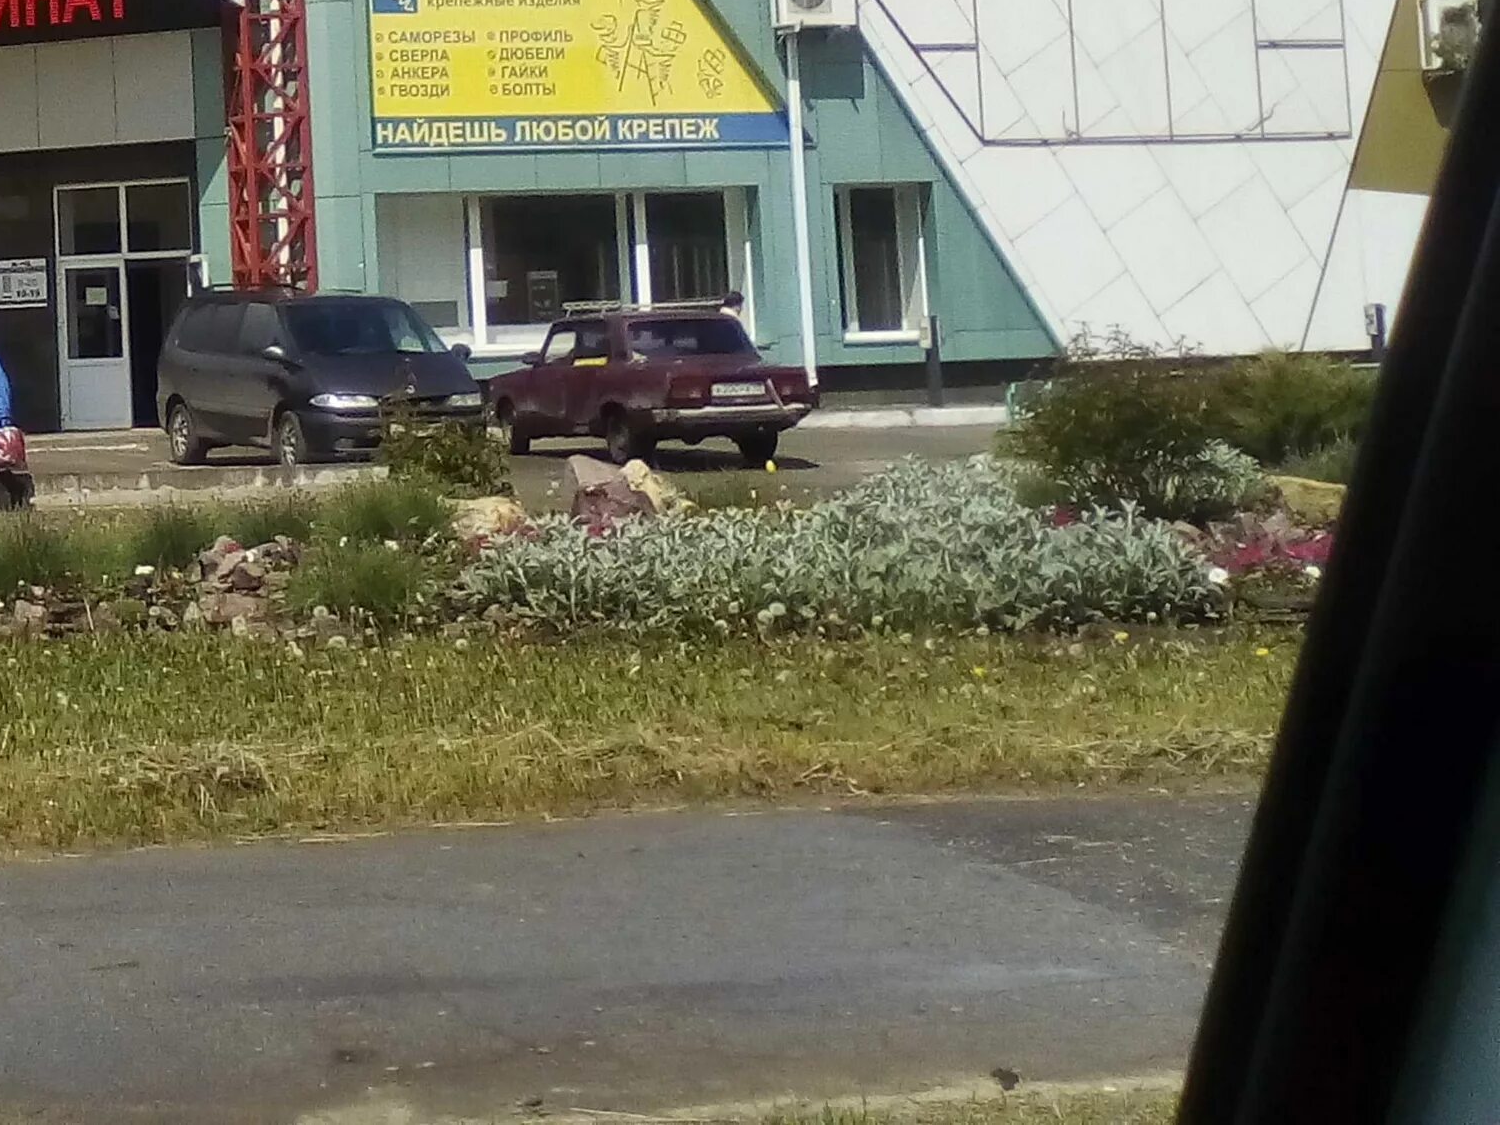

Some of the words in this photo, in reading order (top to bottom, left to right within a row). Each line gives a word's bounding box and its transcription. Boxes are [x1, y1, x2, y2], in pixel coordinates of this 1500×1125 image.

[388, 30, 475, 44] САМОРЕЗЫ
[499, 29, 573, 43] ПРОФИЛЬ
[389, 49, 450, 62] СВЕРЛА
[499, 47, 565, 62] ДЮБЕЛИ
[390, 66, 449, 80] АНКЕРА
[501, 62, 548, 78] ГАЙКИ
[390, 83, 450, 99] ГВОЗДИ
[502, 82, 556, 96] БОЛТЫ
[376, 118, 507, 146] НАЙДЕШЬ
[514, 116, 611, 143] ЛЮБОЙ
[617, 118, 720, 140] КРЕПЕЖ
